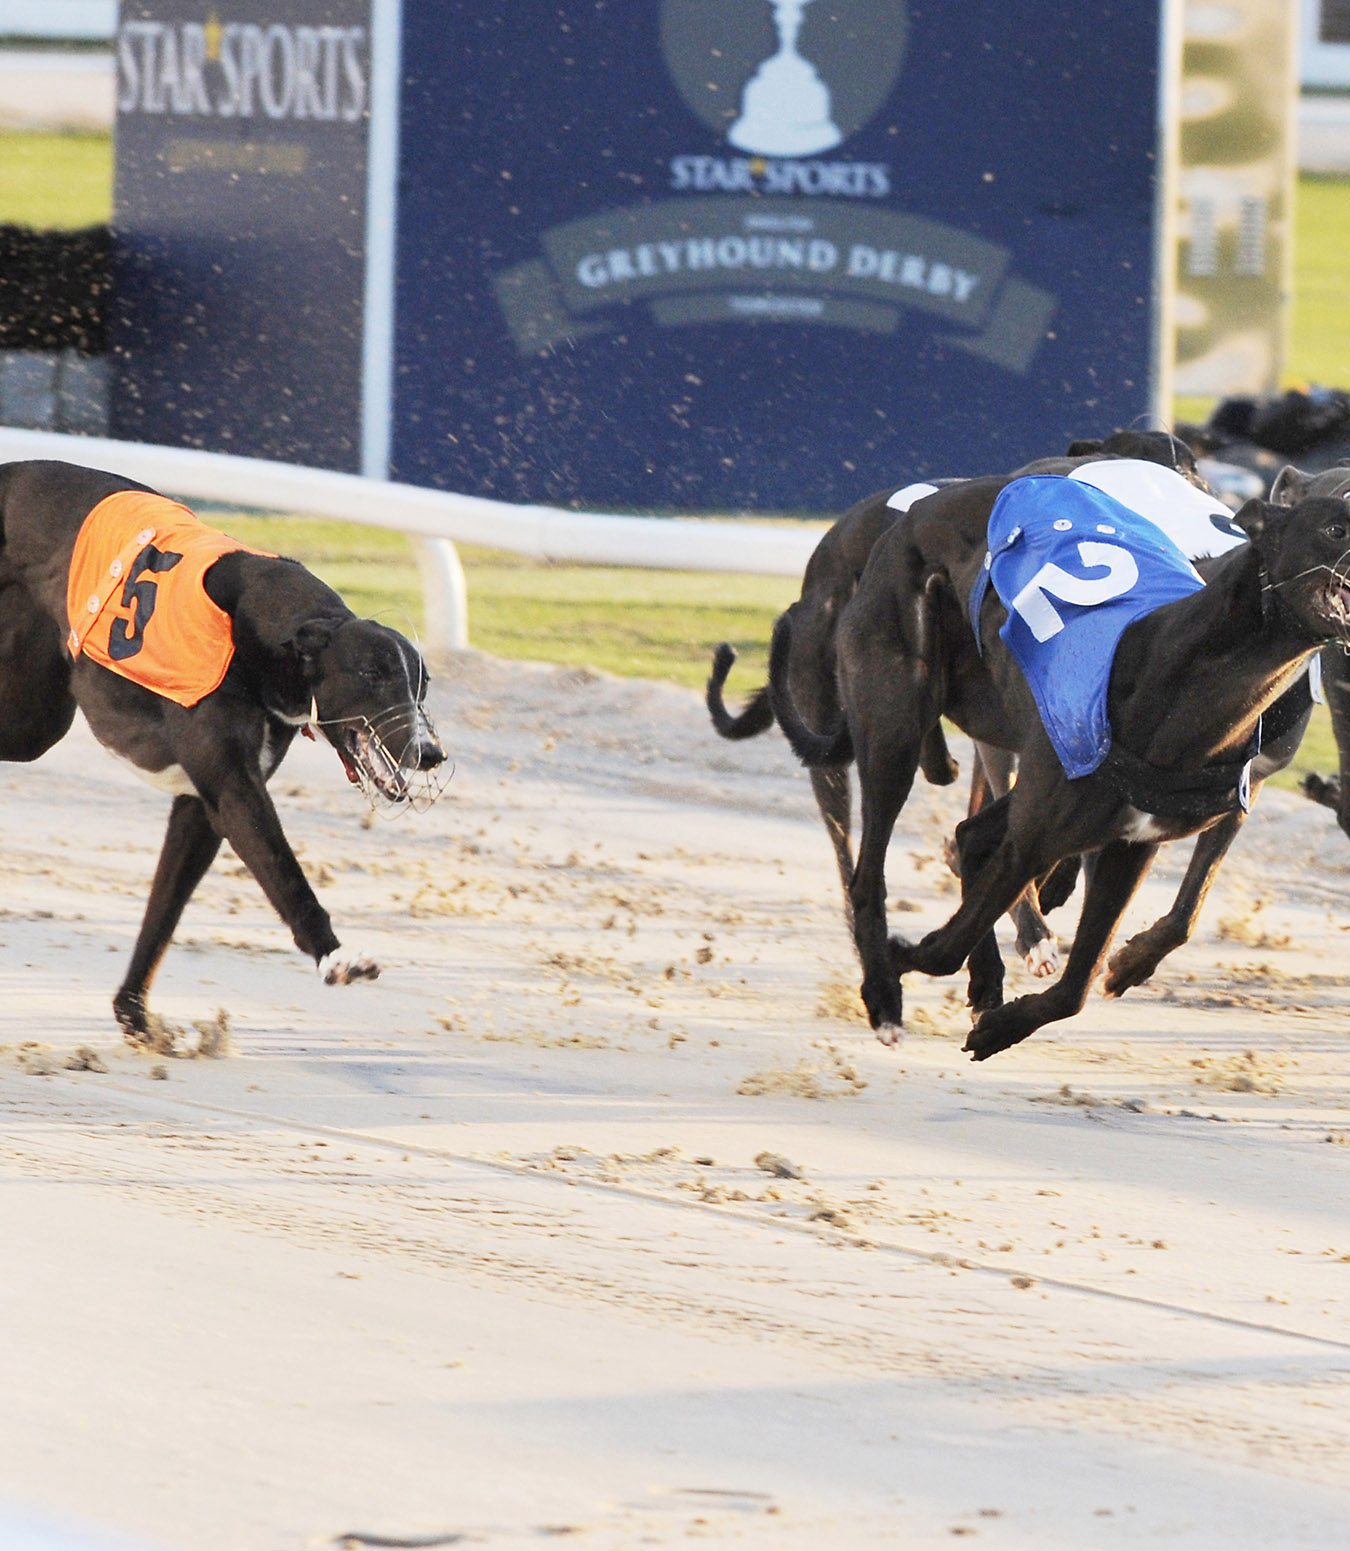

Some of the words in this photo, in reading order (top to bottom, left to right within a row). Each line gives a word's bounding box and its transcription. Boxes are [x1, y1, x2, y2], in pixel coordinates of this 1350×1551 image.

[119, 21, 211, 115] STAR
[217, 22, 365, 122] SPORTS
[671, 156, 752, 191] STAR
[763, 159, 890, 197] SPORTS
[576, 236, 838, 288] GREYHOUND
[847, 244, 980, 302] DERBY
[108, 544, 184, 661] 5
[1012, 541, 1139, 643] 2
